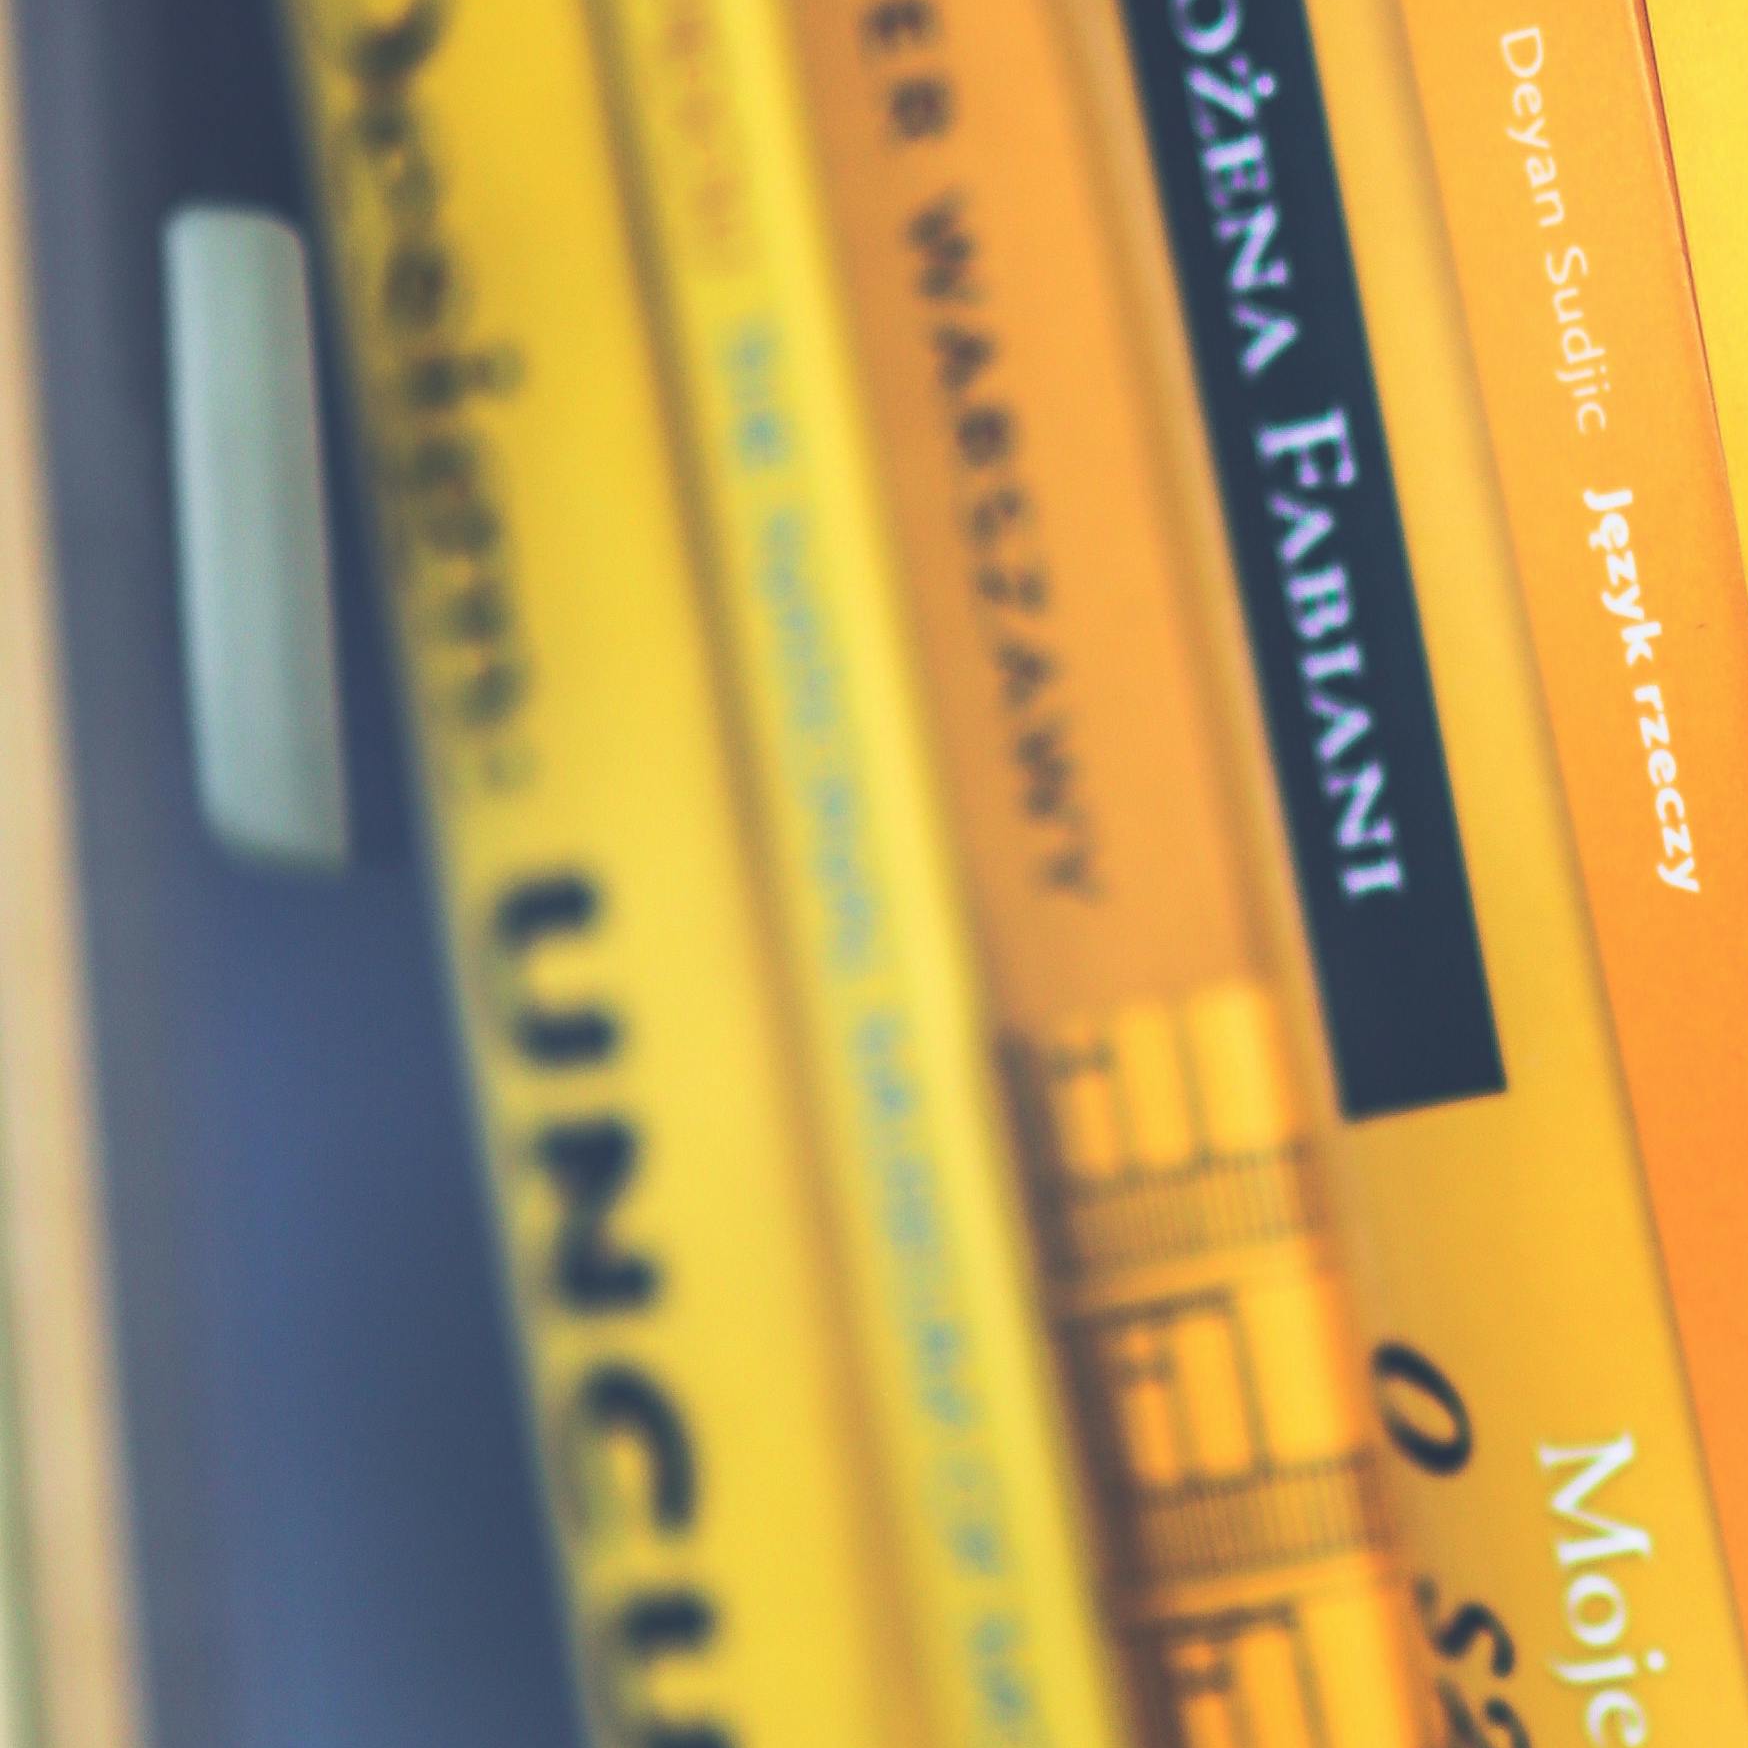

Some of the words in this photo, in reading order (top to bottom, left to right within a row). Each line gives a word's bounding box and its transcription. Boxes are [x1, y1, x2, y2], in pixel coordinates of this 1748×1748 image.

[1257, 405, 1403, 908] FABIANI
[1500, 25, 1567, 228] Deyan
[1544, 245, 1611, 435] Sudjic
[1582, 487, 1663, 667] Język
[1631, 682, 1701, 895] rzeczy
